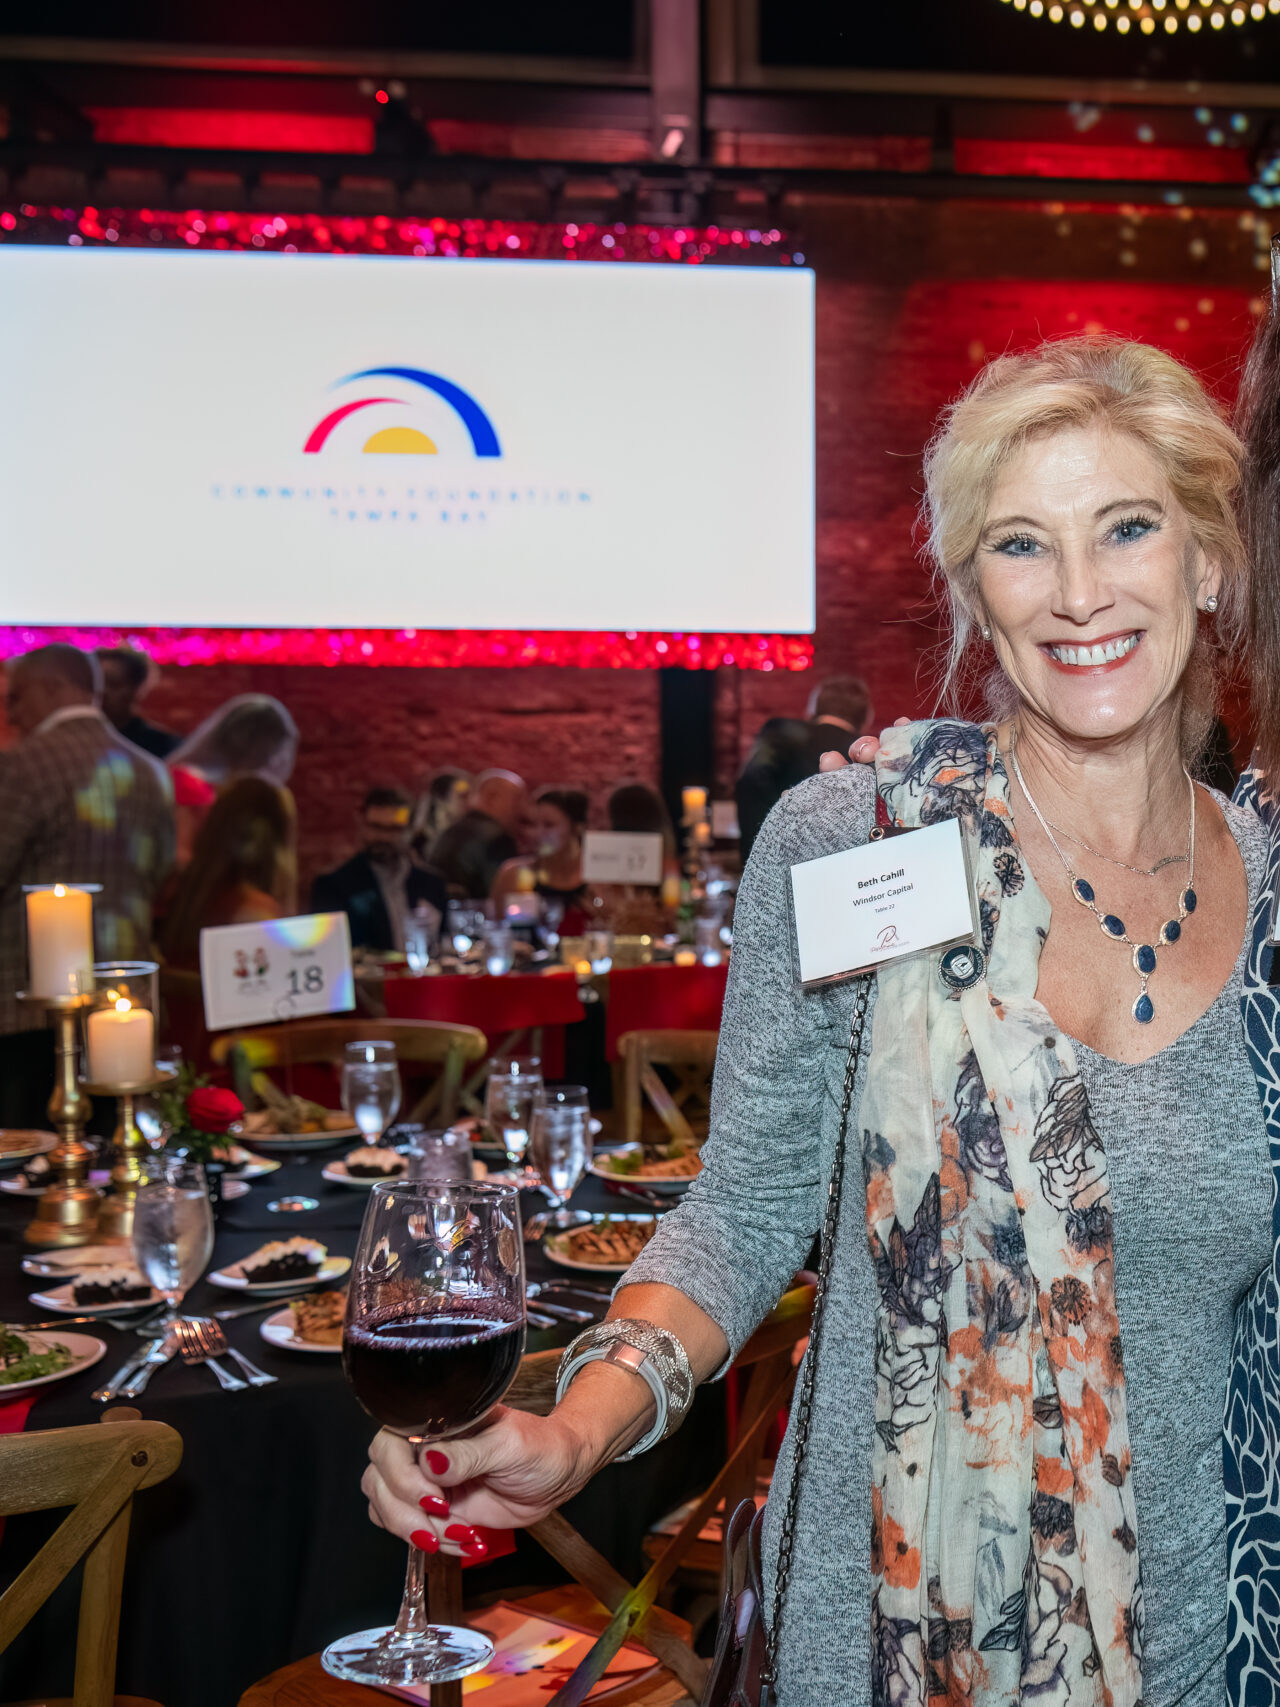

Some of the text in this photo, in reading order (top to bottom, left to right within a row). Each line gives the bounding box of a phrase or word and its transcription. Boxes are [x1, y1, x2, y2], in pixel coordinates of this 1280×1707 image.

[857, 868, 905, 889] Beth Cahill
[853, 882, 914, 907] Windsor Capital
[287, 965, 324, 996] 18
